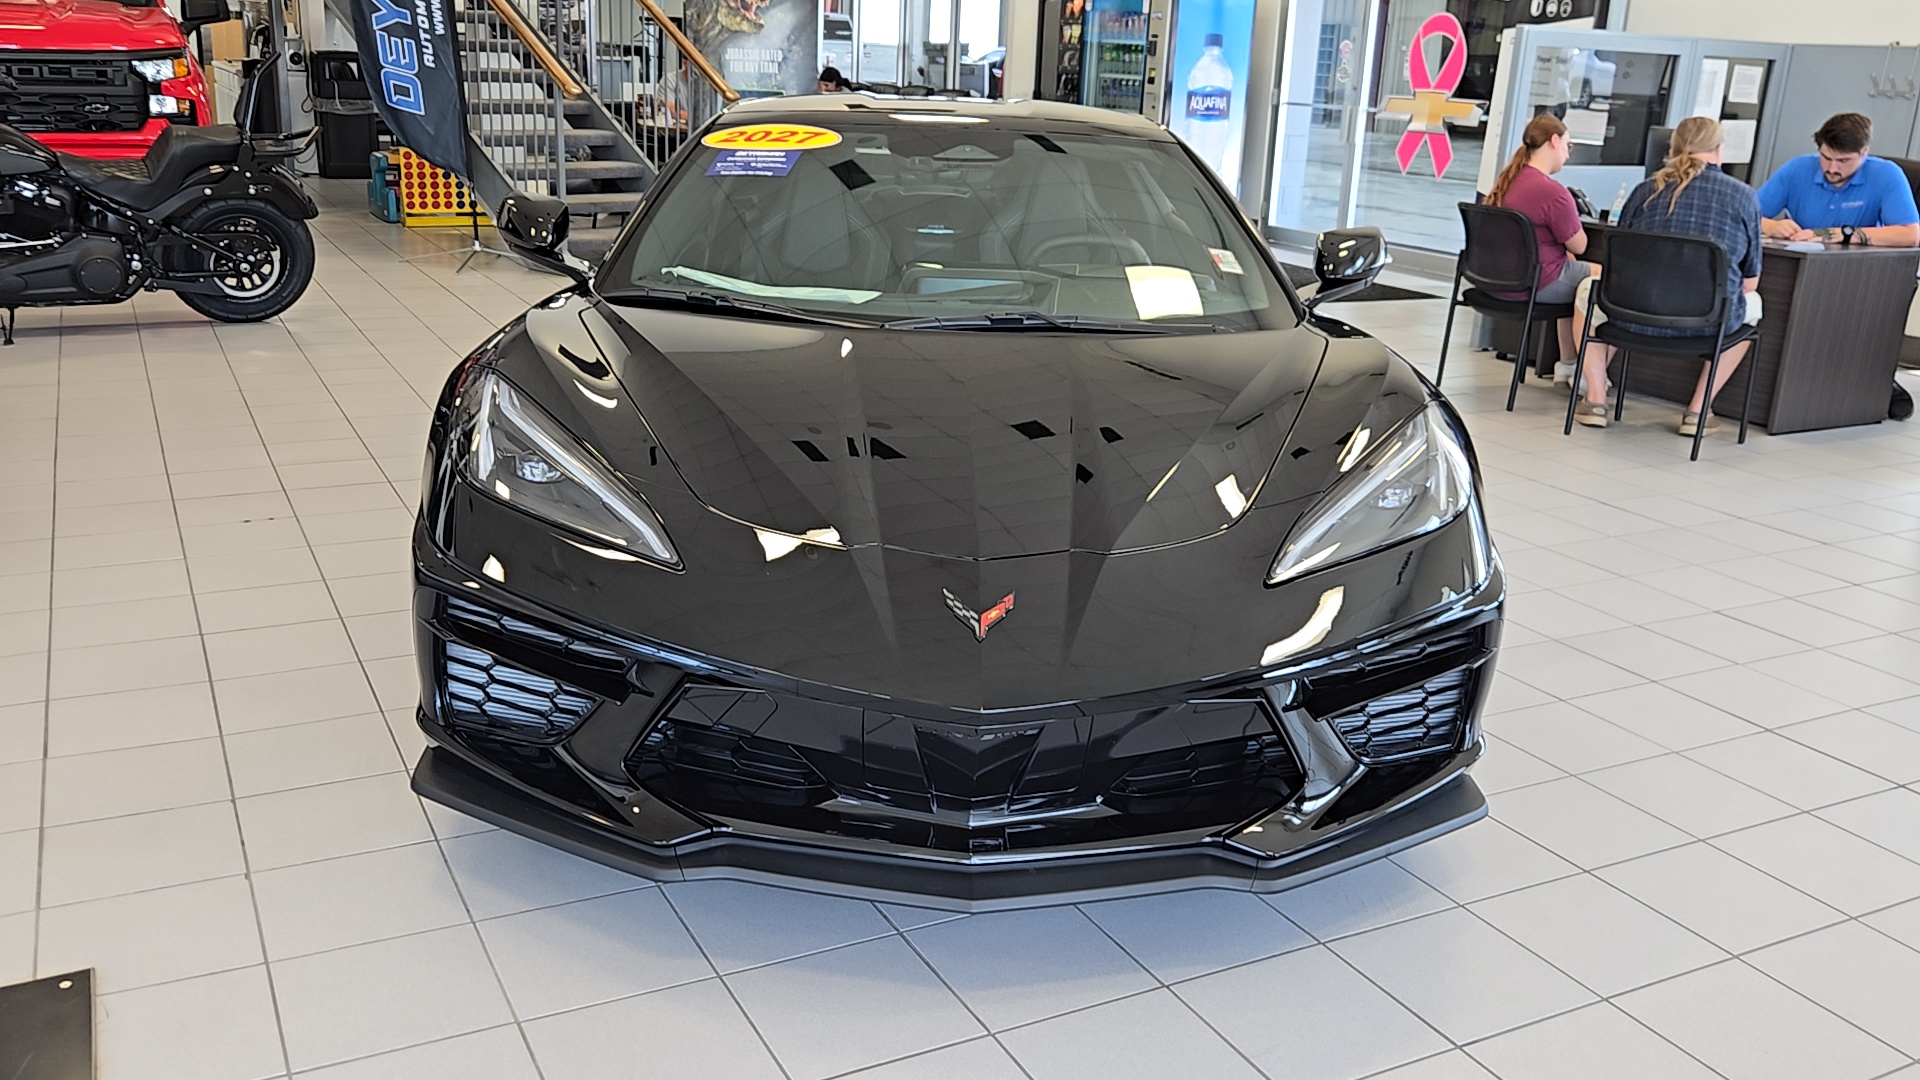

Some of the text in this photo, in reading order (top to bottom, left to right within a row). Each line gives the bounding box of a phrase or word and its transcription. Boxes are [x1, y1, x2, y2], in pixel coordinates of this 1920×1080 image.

[371, 0, 425, 115] DEY
[726, 48, 783, 62] JURASSIC RATED
[730, 61, 779, 74] FOR ANY TRAIL
[1189, 95, 1228, 111] AQUAFINA
[717, 130, 827, 143] 2027
